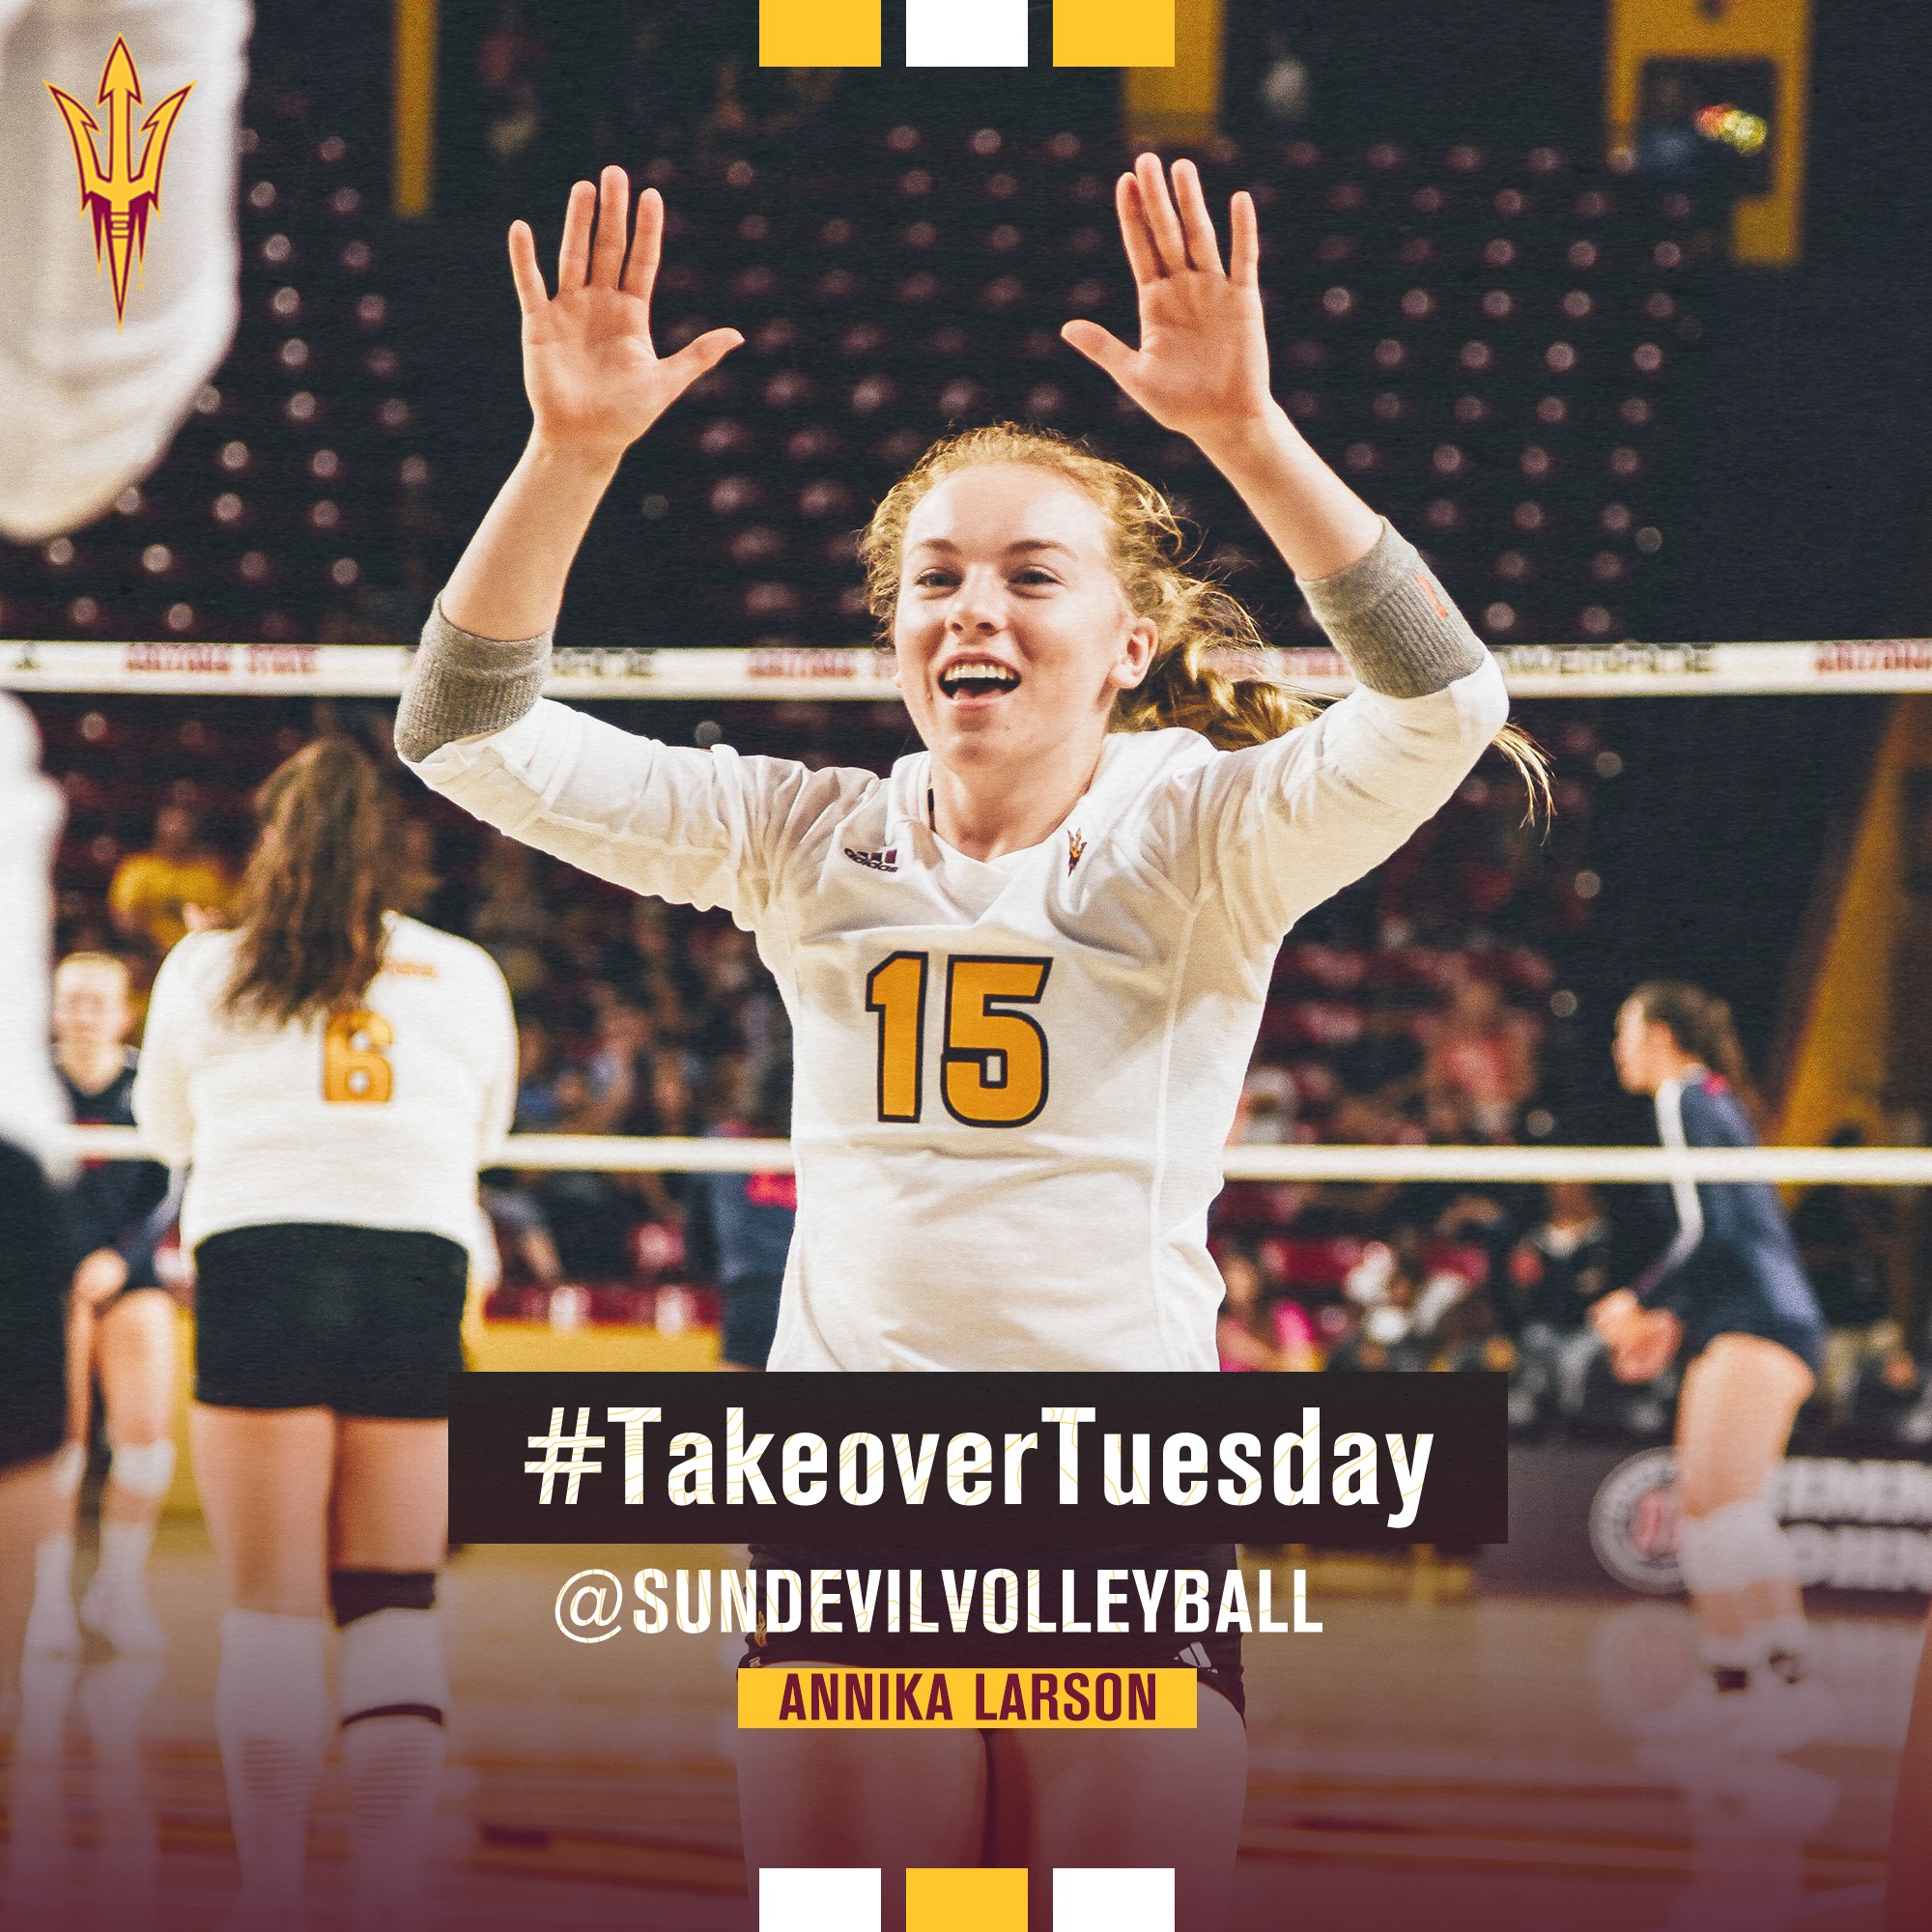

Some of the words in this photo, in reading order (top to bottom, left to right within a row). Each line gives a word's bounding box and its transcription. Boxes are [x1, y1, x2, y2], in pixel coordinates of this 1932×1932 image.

[843, 847, 899, 873] adidas
[323, 1009, 394, 1103] 6
[865, 950, 1054, 1129] 15
